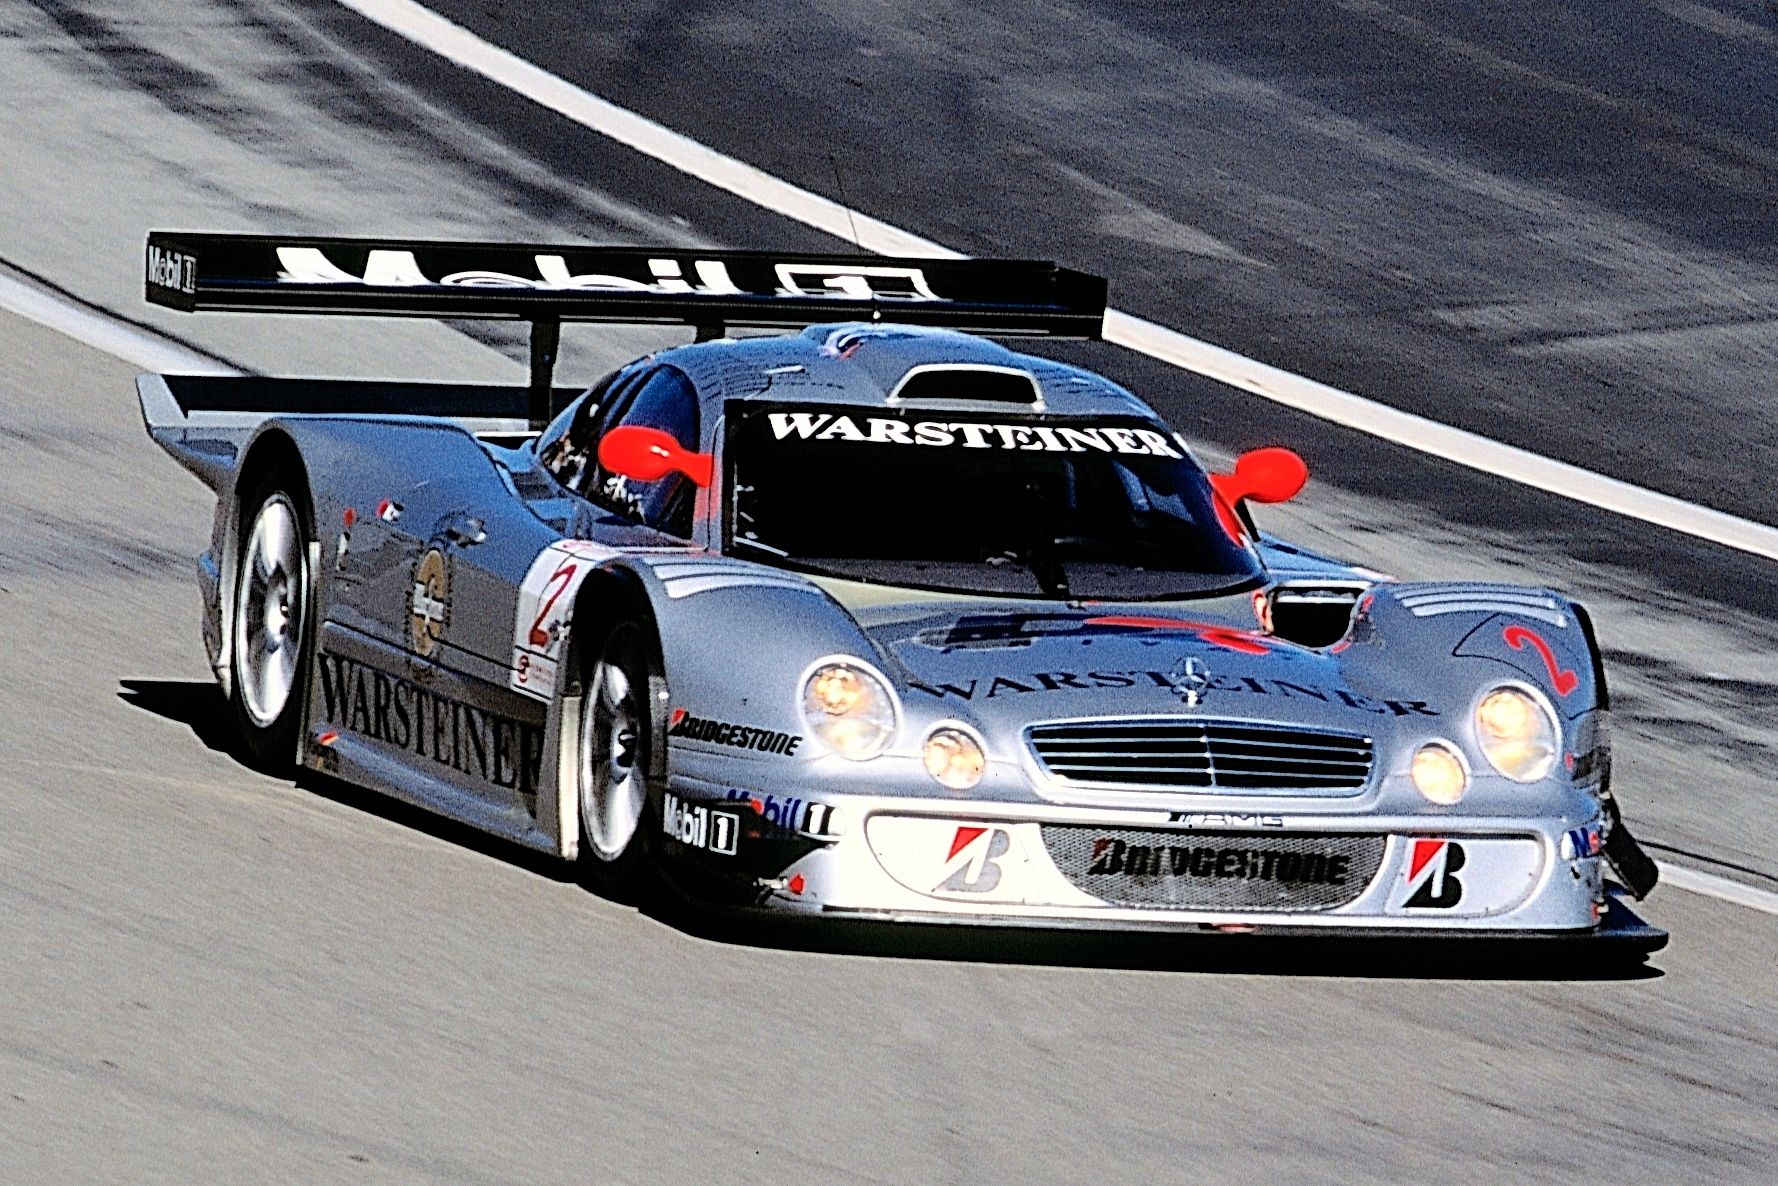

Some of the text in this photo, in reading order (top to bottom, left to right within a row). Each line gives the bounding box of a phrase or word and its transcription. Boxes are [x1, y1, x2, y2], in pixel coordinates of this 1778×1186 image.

[148, 245, 197, 294] Mobil 1
[766, 411, 1184, 460] WARSTEINER
[527, 563, 578, 648] 2
[1503, 625, 1579, 697] 2
[907, 671, 1441, 717] WARSTEINER
[663, 792, 740, 856] Mobil 1
